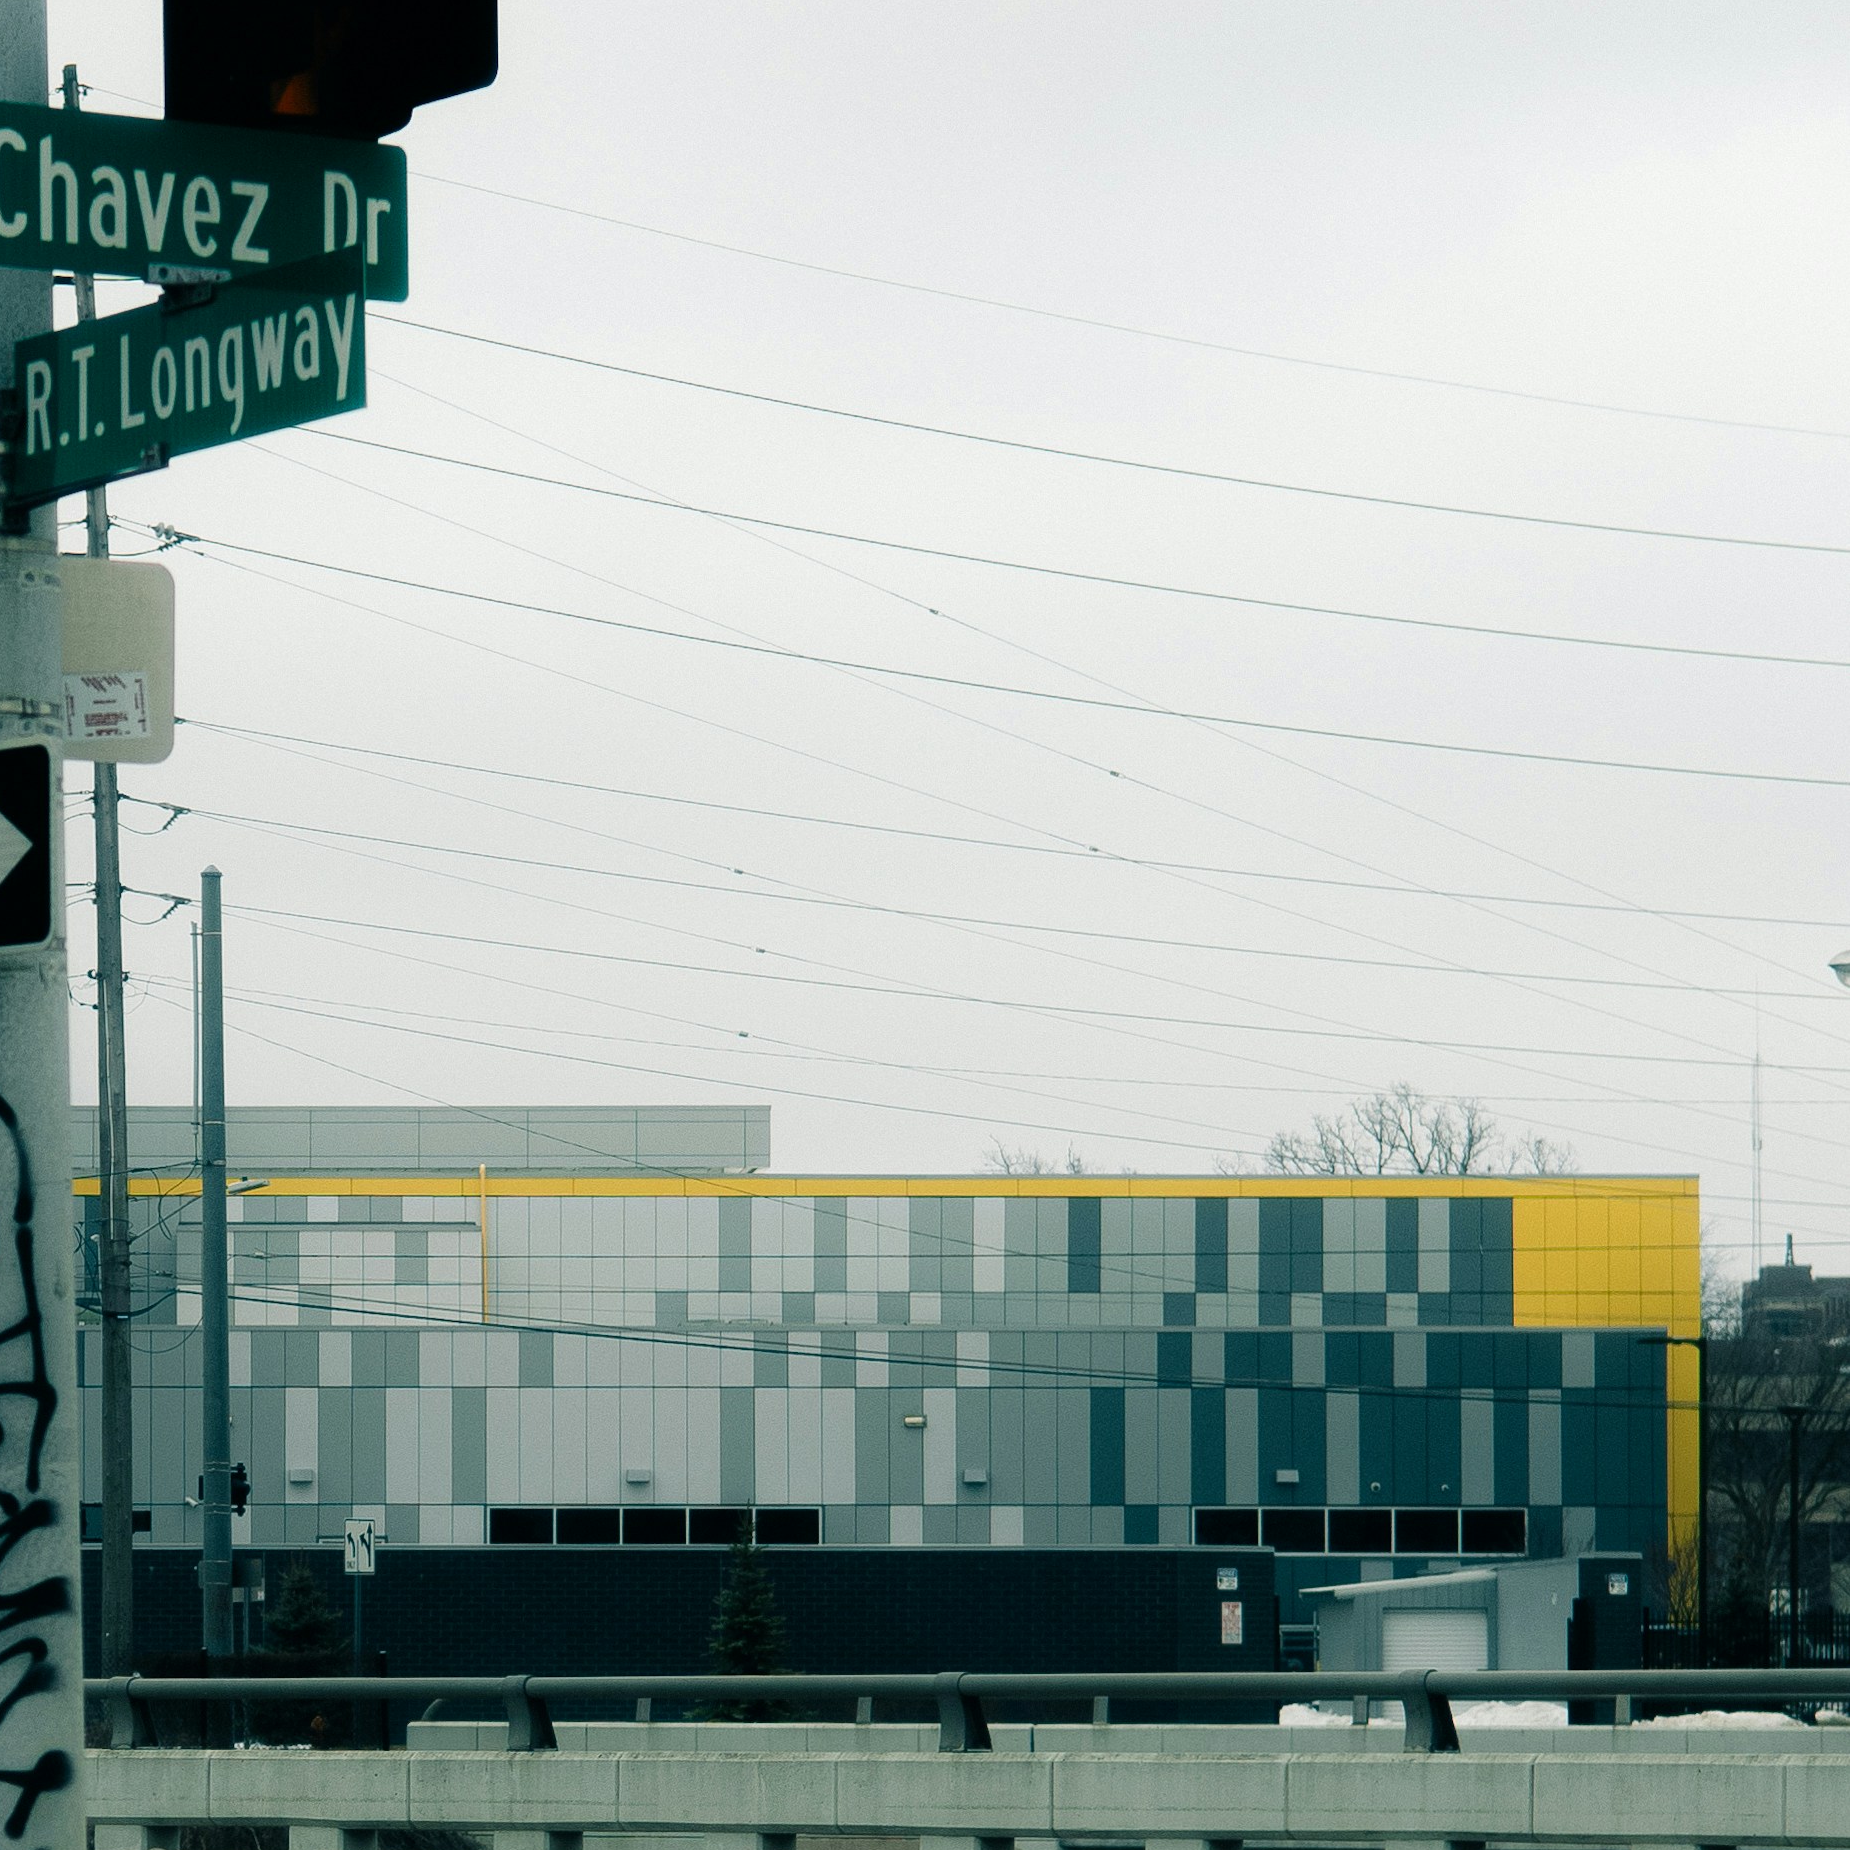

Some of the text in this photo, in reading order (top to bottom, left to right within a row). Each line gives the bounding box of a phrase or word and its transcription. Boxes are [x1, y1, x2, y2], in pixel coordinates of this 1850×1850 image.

[324, 170, 391, 265] Dr
[26, 293, 356, 456] R.T. Longway
